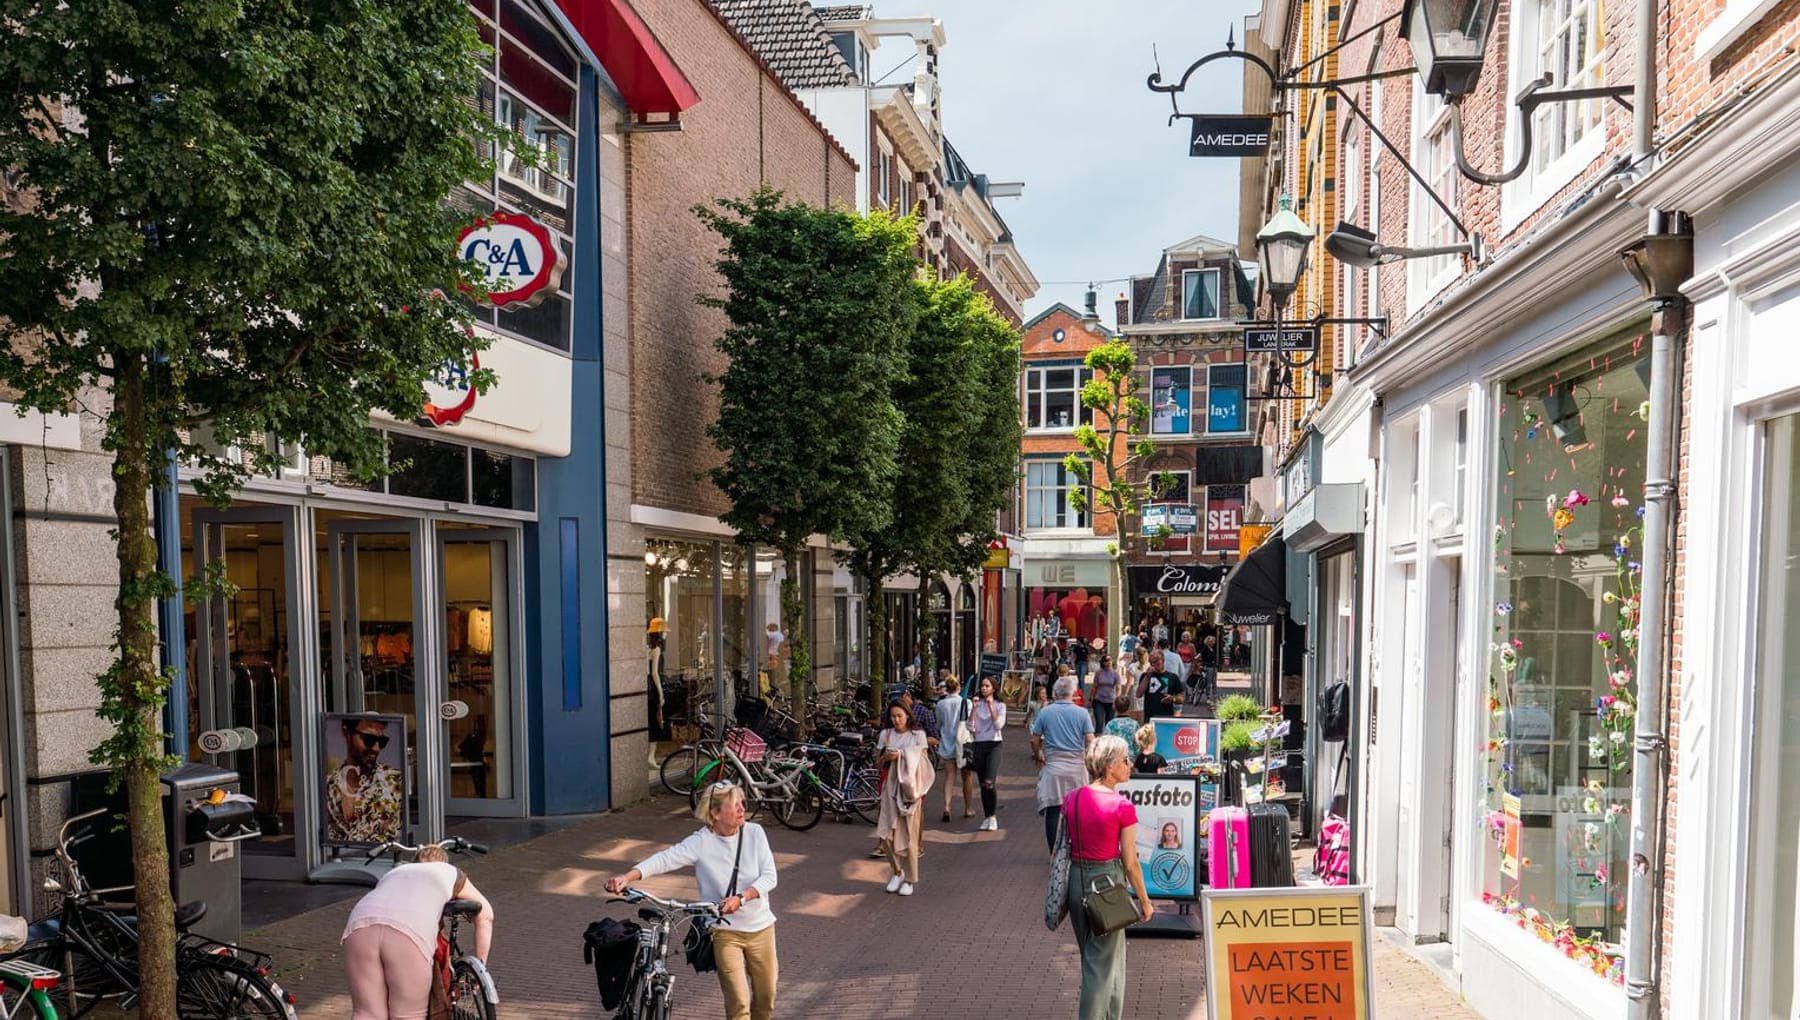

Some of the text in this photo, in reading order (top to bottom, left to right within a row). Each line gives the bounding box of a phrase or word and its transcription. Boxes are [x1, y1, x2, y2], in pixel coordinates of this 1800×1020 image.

[1193, 133, 1268, 146] AMEDEE
[465, 238, 535, 277] C&A
[1258, 332, 1303, 342] JUWLIER
[1042, 565, 1075, 582] WE
[1177, 735, 1198, 746] STOP
[1216, 906, 1360, 928] AMEDEE
[1233, 949, 1349, 972] LAATSTE
[1241, 982, 1342, 1005] WEKEN
